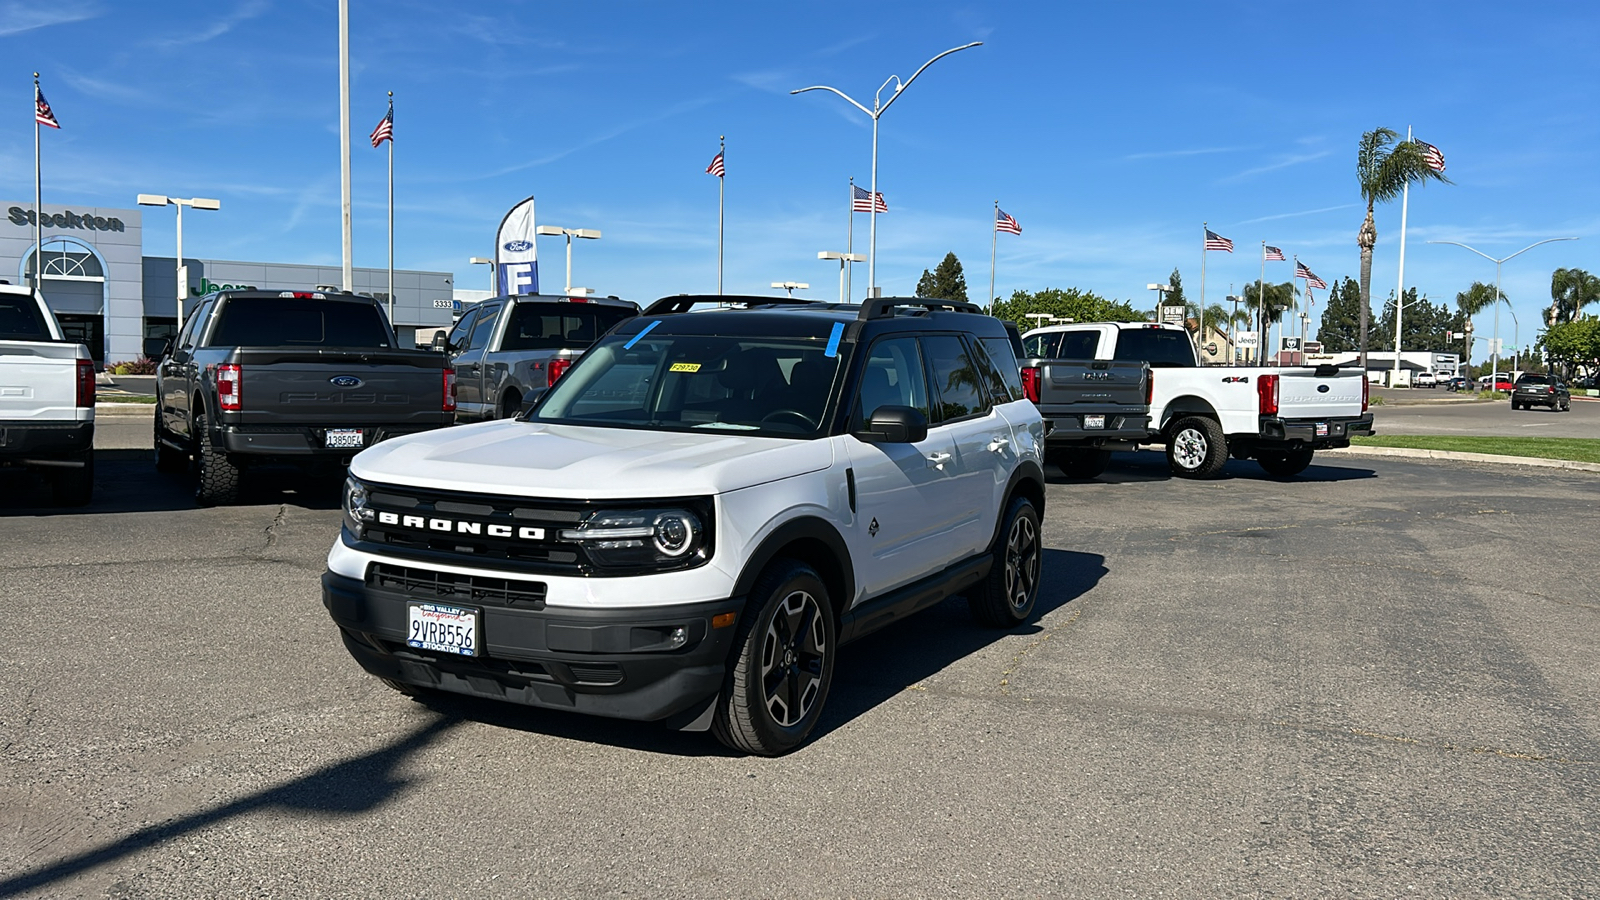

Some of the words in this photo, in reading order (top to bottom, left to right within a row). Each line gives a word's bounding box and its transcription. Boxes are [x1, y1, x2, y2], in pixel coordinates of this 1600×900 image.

[8, 206, 125, 232] Stockton
[434, 300, 452, 308] 3333
[1164, 307, 1183, 315] OEM
[1238, 336, 1257, 345] Jeep
[279, 391, 409, 404] F-150
[1284, 395, 1327, 403] SUPER
[1329, 394, 1359, 402] DUTY
[379, 511, 545, 540] BRONCO
[437, 606, 460, 615] VALLEY
[412, 619, 473, 648] 9VRB556
[422, 641, 460, 654] STOCKTON
